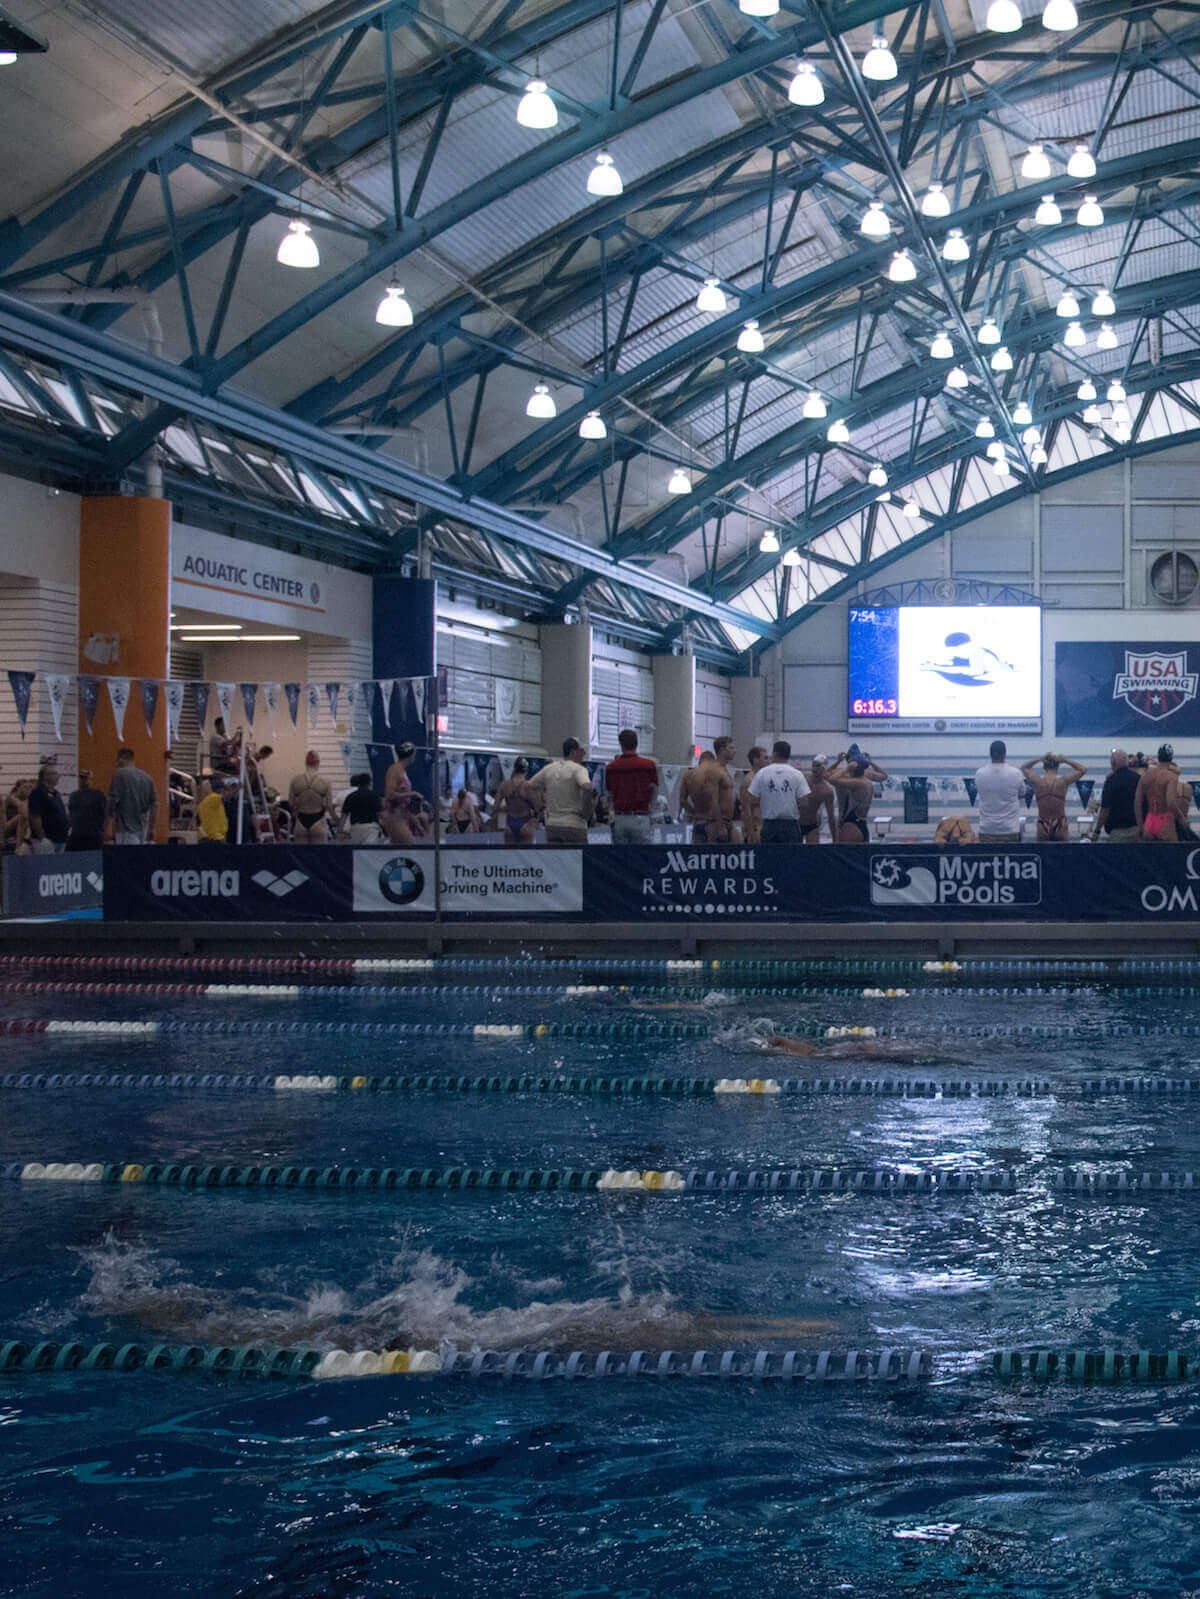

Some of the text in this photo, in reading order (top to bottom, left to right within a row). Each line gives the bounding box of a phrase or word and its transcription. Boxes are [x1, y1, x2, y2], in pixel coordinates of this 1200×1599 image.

[183, 555, 304, 599] AQUATIC CENTER
[1133, 660, 1178, 678] USA
[1121, 678, 1190, 689] SWIMMING
[853, 698, 897, 714] 6:16.3
[452, 864, 544, 878] The Ultimate
[660, 849, 756, 874] Marriott
[939, 855, 1038, 885] Myrtha
[38, 871, 83, 897] arena
[150, 869, 240, 897] arena
[438, 881, 553, 896] Driving Machine
[939, 879, 1015, 904] Pools
